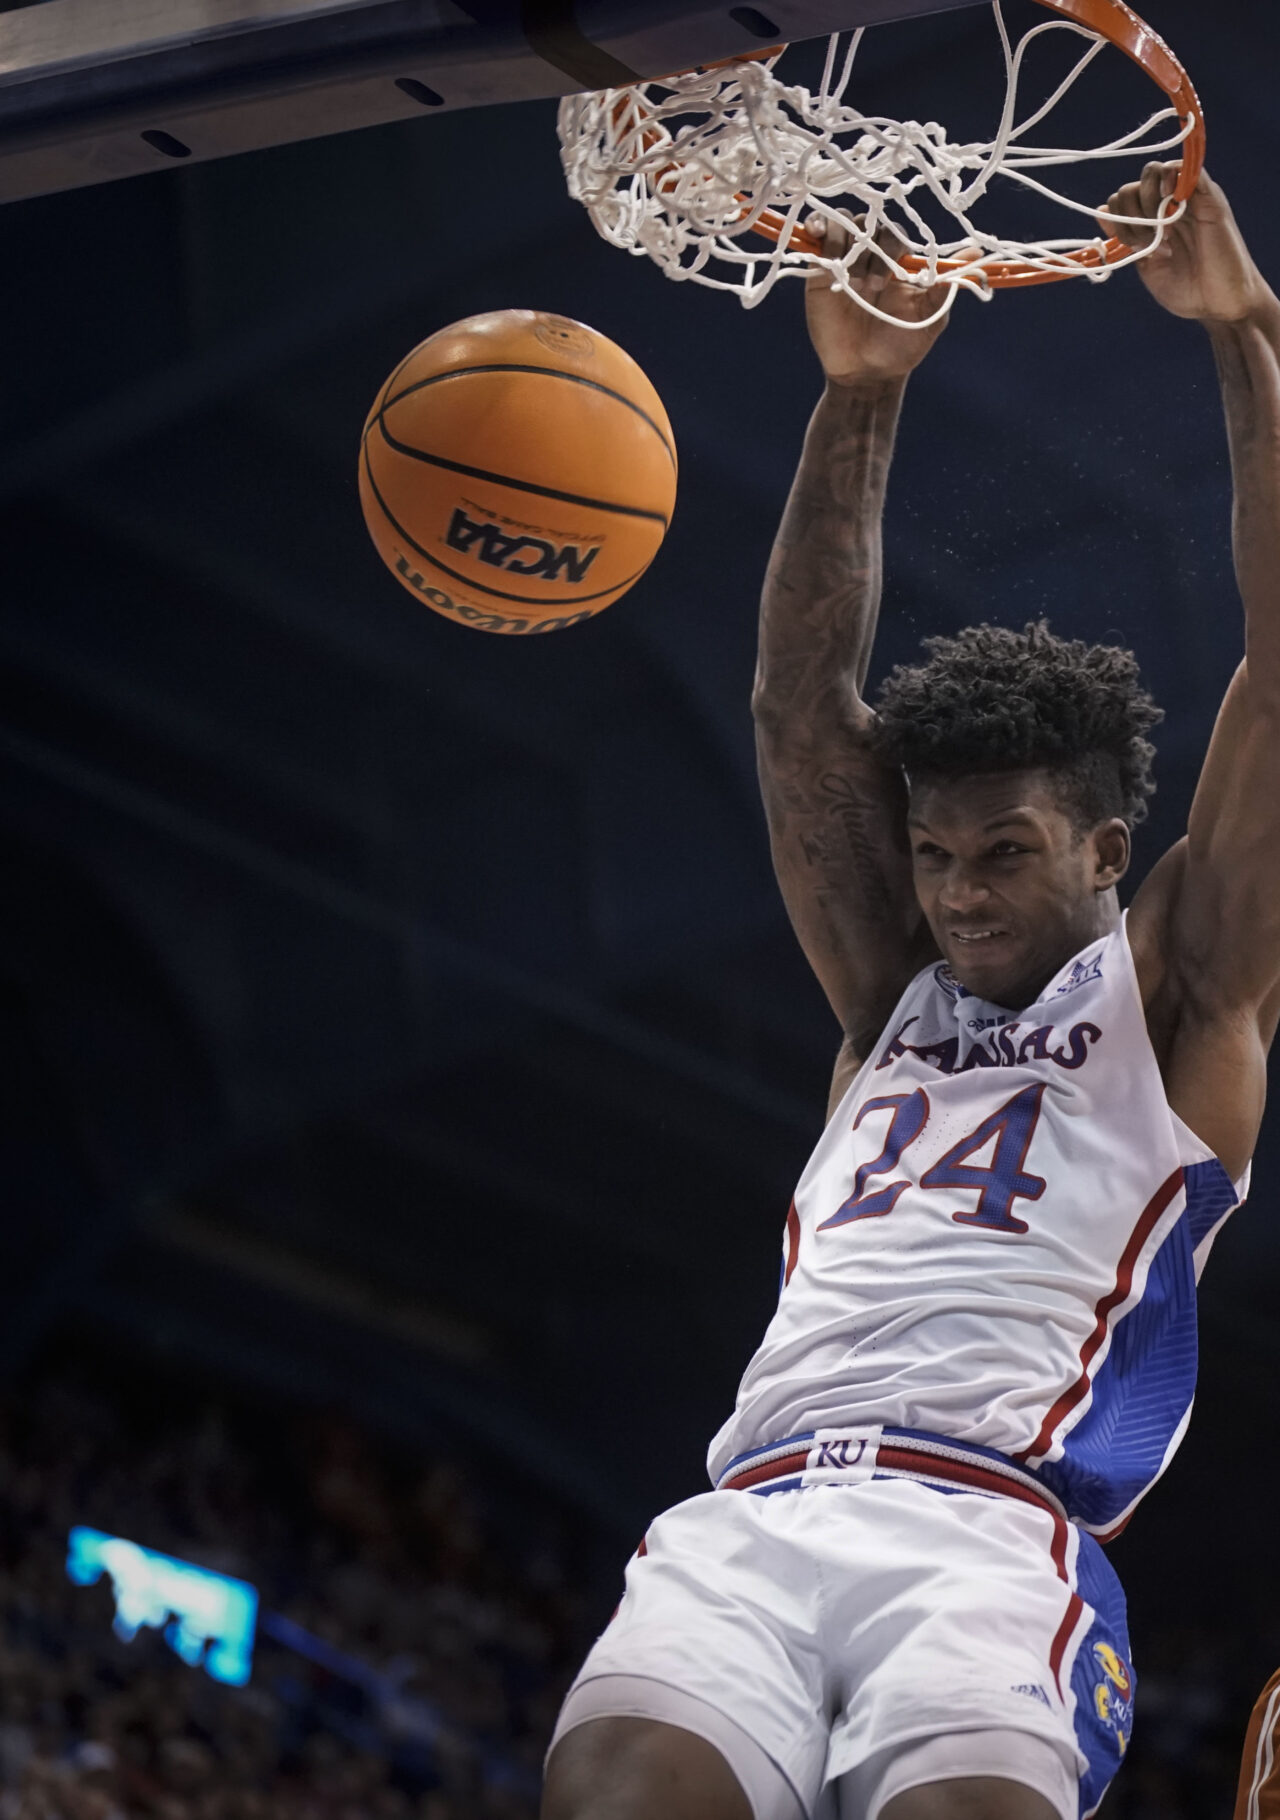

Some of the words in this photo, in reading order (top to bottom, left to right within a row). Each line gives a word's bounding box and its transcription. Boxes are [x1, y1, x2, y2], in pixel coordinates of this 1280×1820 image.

[445, 507, 602, 583] NCAA
[874, 1015, 1103, 1076] KANSAS
[815, 1082, 1048, 1234] 24
[815, 1439, 869, 1470] KU
